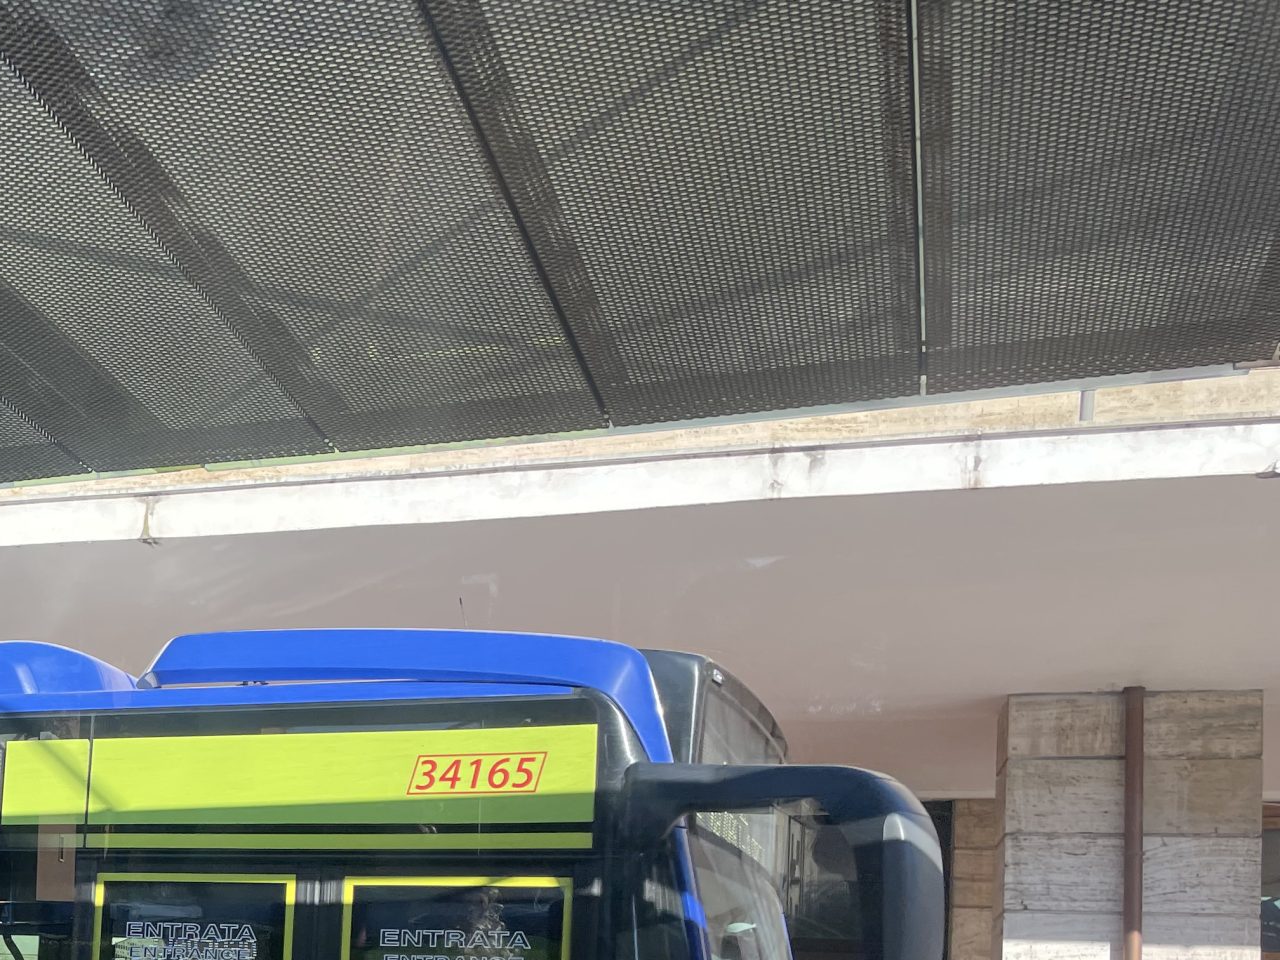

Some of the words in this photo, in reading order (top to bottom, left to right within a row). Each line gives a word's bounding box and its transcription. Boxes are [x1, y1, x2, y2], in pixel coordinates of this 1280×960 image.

[414, 756, 537, 791] 34165
[125, 921, 258, 943] ENTRATA
[379, 928, 532, 950] ENTRATA
